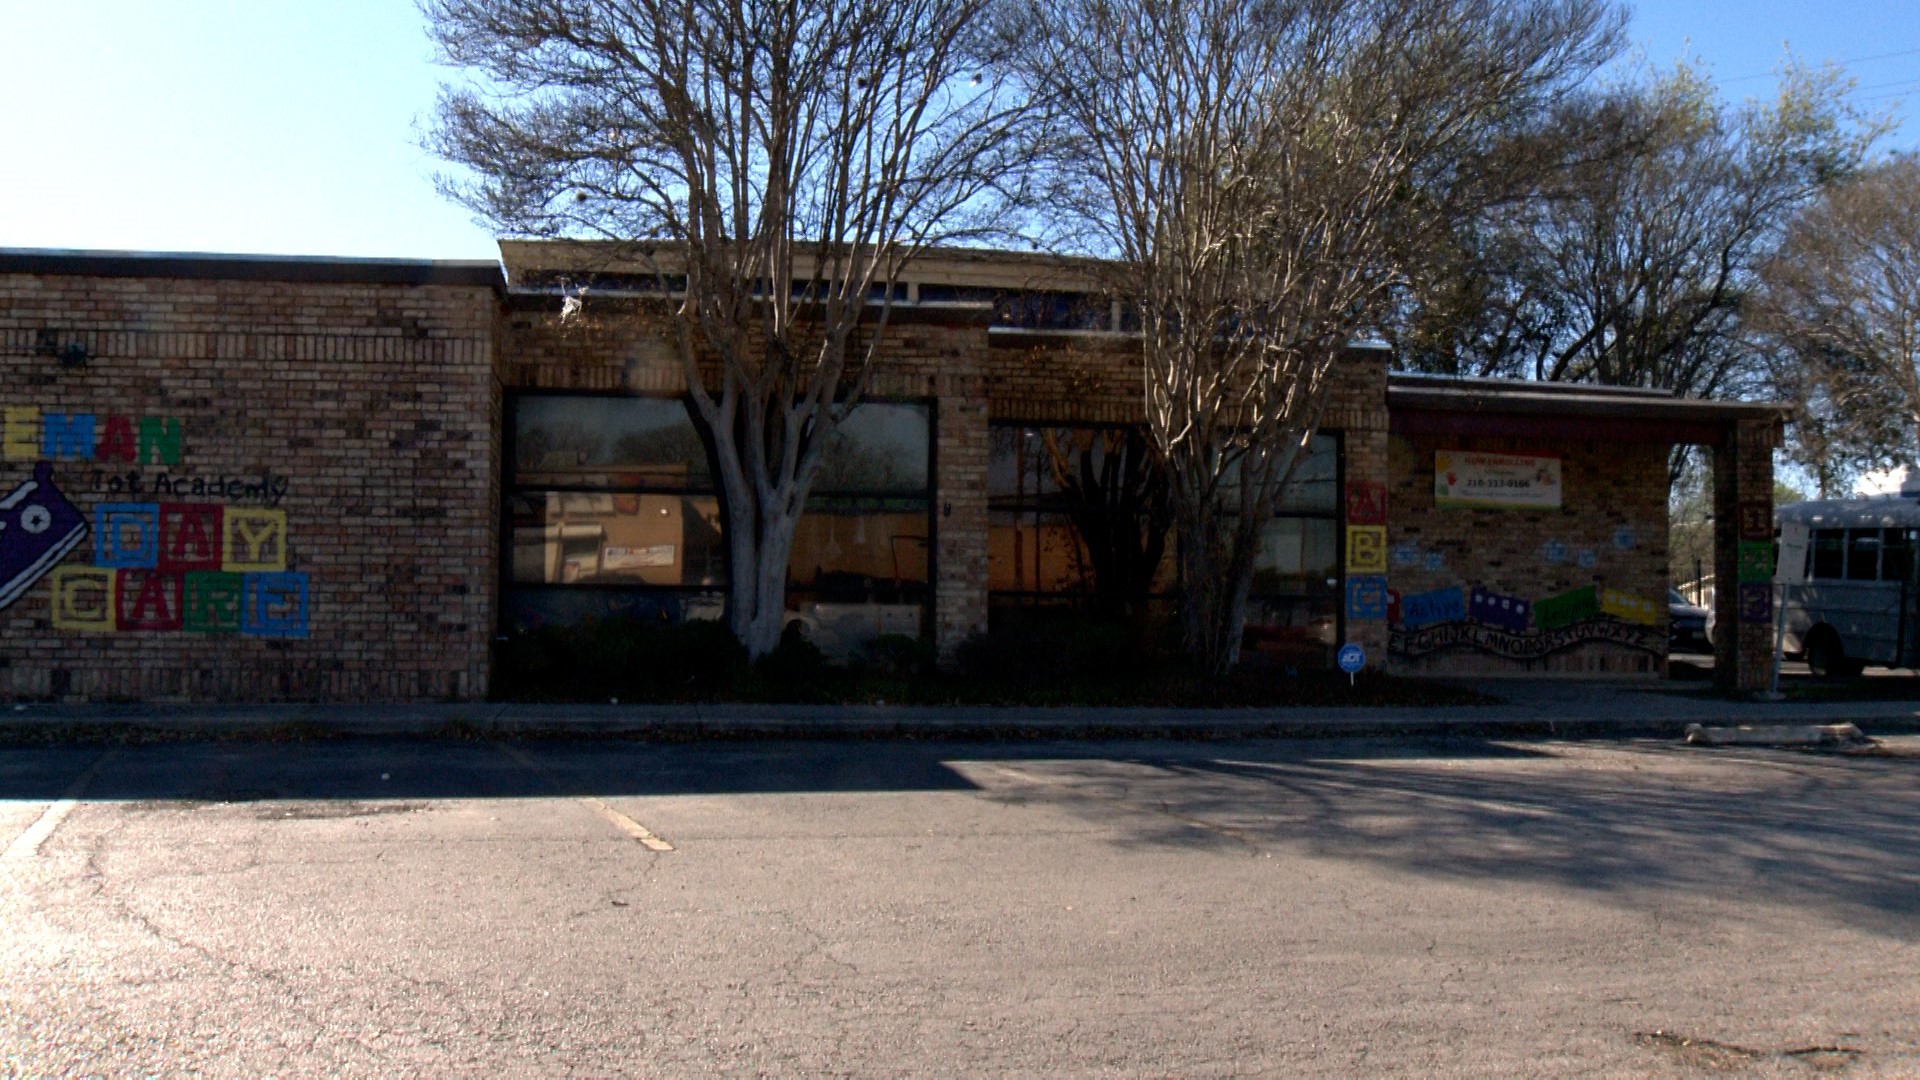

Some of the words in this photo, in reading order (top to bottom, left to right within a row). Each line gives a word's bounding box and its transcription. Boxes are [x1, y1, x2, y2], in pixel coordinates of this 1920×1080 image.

[4, 405, 181, 465] EMAN
[91, 469, 143, 494] Tot
[154, 471, 288, 505] Academy
[106, 511, 280, 565] DAY
[58, 574, 300, 628] CARE
